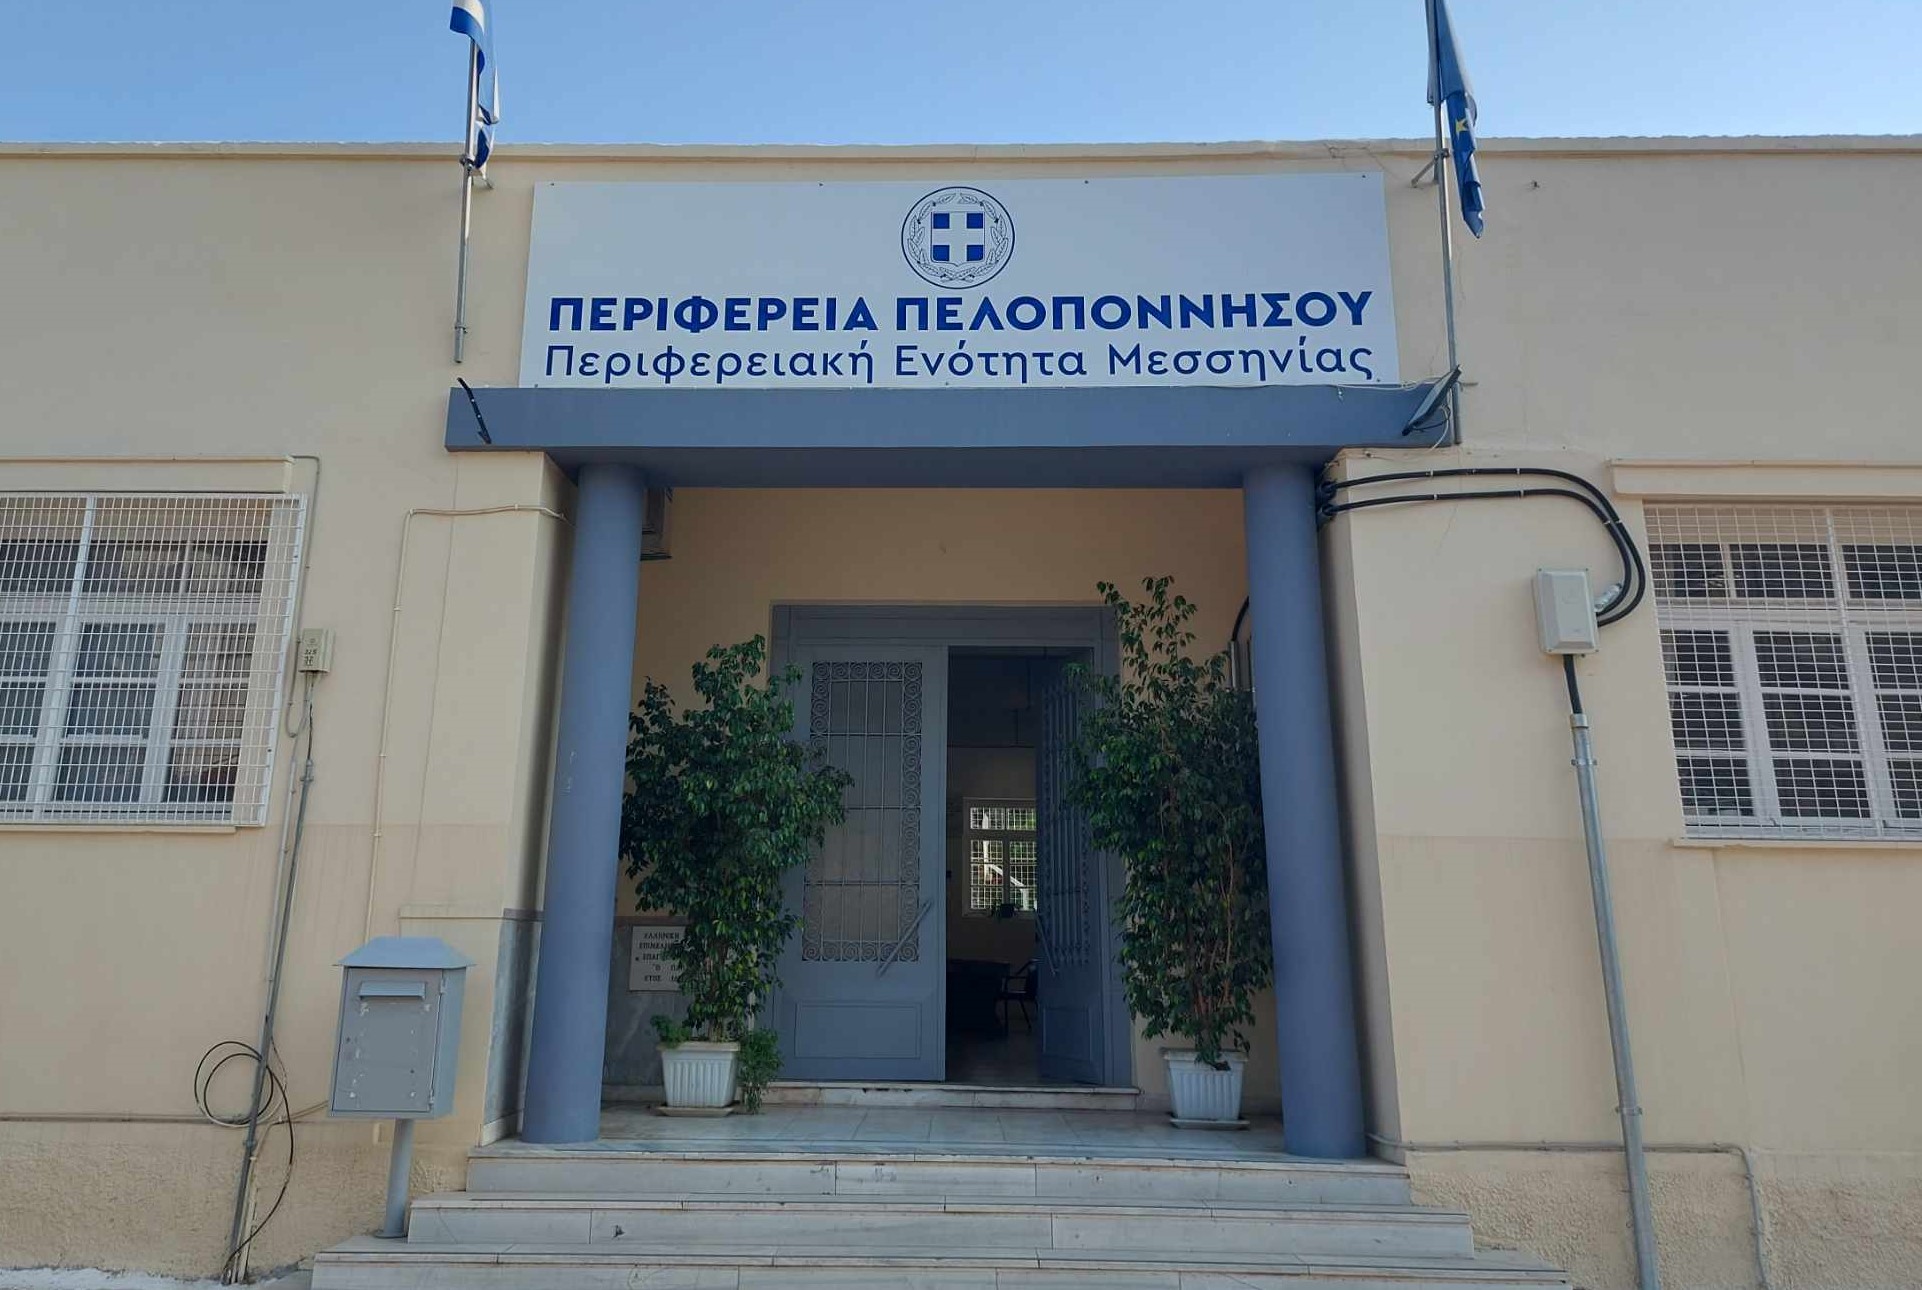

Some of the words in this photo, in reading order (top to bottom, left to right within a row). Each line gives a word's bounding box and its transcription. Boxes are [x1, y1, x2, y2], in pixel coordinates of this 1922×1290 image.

[549, 295, 879, 333] ΠΕΡΙΦΕΡΕΙΑ
[896, 291, 1373, 331] ΠΕΛΟΠΟΝΝΗΣΟΥ
[545, 340, 874, 384] Περιφερειακή
[896, 340, 1087, 384] Ενότητα
[1108, 336, 1373, 381] Μεσσηνίας
